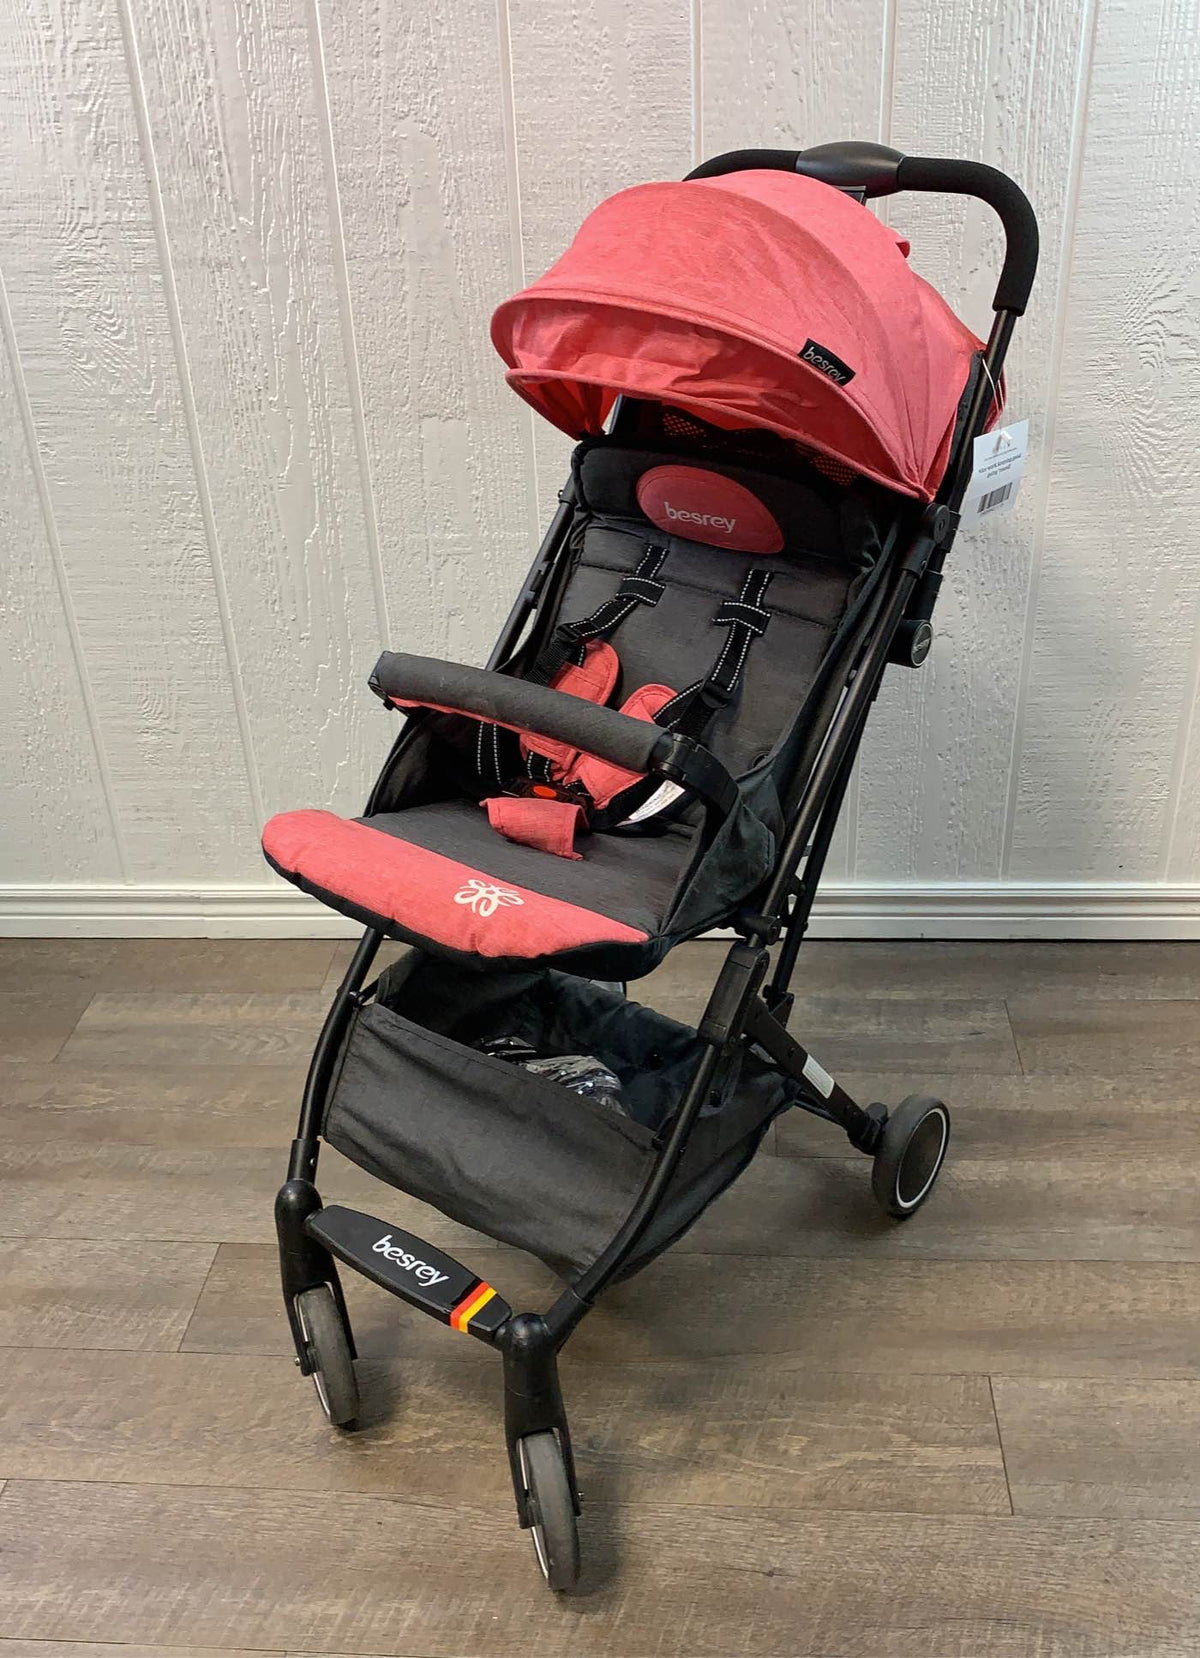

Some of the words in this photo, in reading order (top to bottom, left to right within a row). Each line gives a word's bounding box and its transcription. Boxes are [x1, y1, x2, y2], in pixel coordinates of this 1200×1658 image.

[803, 346, 846, 382] besrey
[664, 501, 736, 533] besrey
[372, 1234, 450, 1287] besrey
